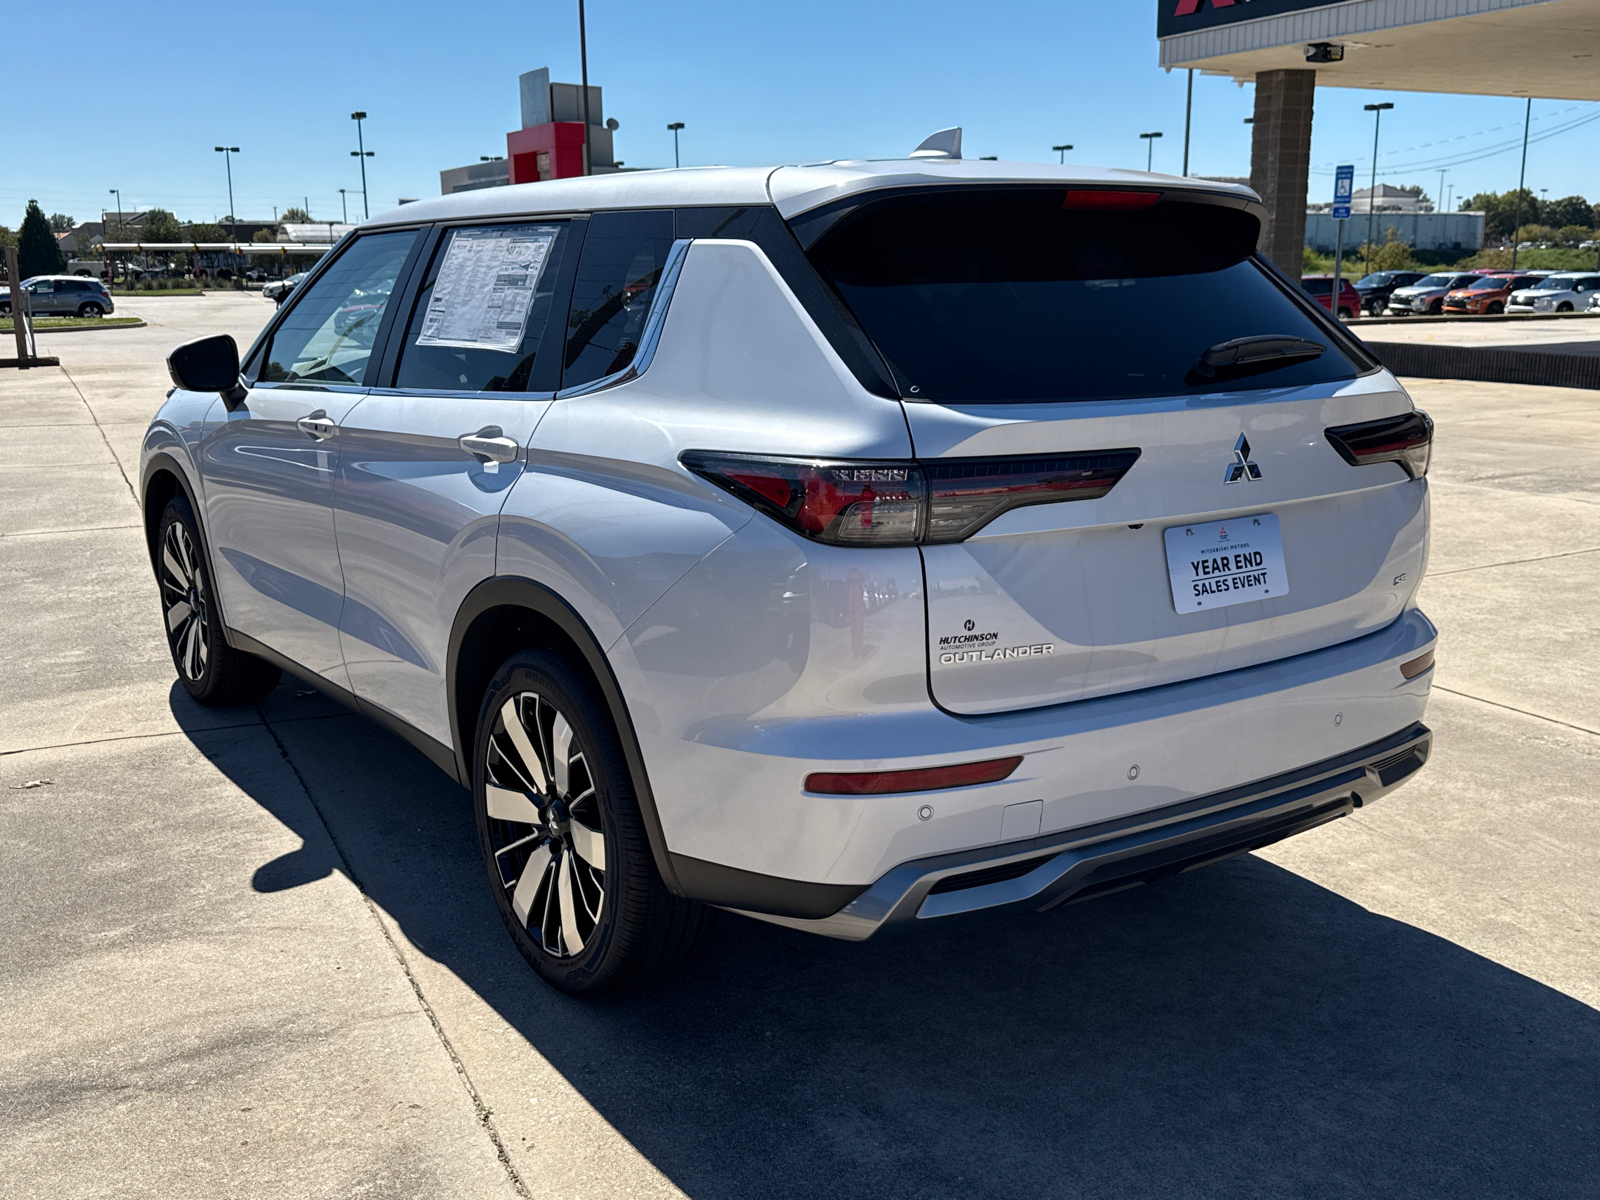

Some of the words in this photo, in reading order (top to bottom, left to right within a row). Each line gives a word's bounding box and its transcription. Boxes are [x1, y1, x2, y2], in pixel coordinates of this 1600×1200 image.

[1200, 545, 1229, 554] MITSUBISHI
[1230, 542, 1250, 551] MOTORS
[1191, 556, 1231, 577] YEAR
[1234, 551, 1263, 570] END
[1193, 578, 1230, 597] SALES
[1232, 572, 1267, 590] EVENT
[939, 632, 999, 645] HUTCHINSON
[940, 642, 976, 651] AUTOMOTIVE
[977, 640, 996, 648] GROUP
[939, 643, 1055, 665] OUTLANDER
